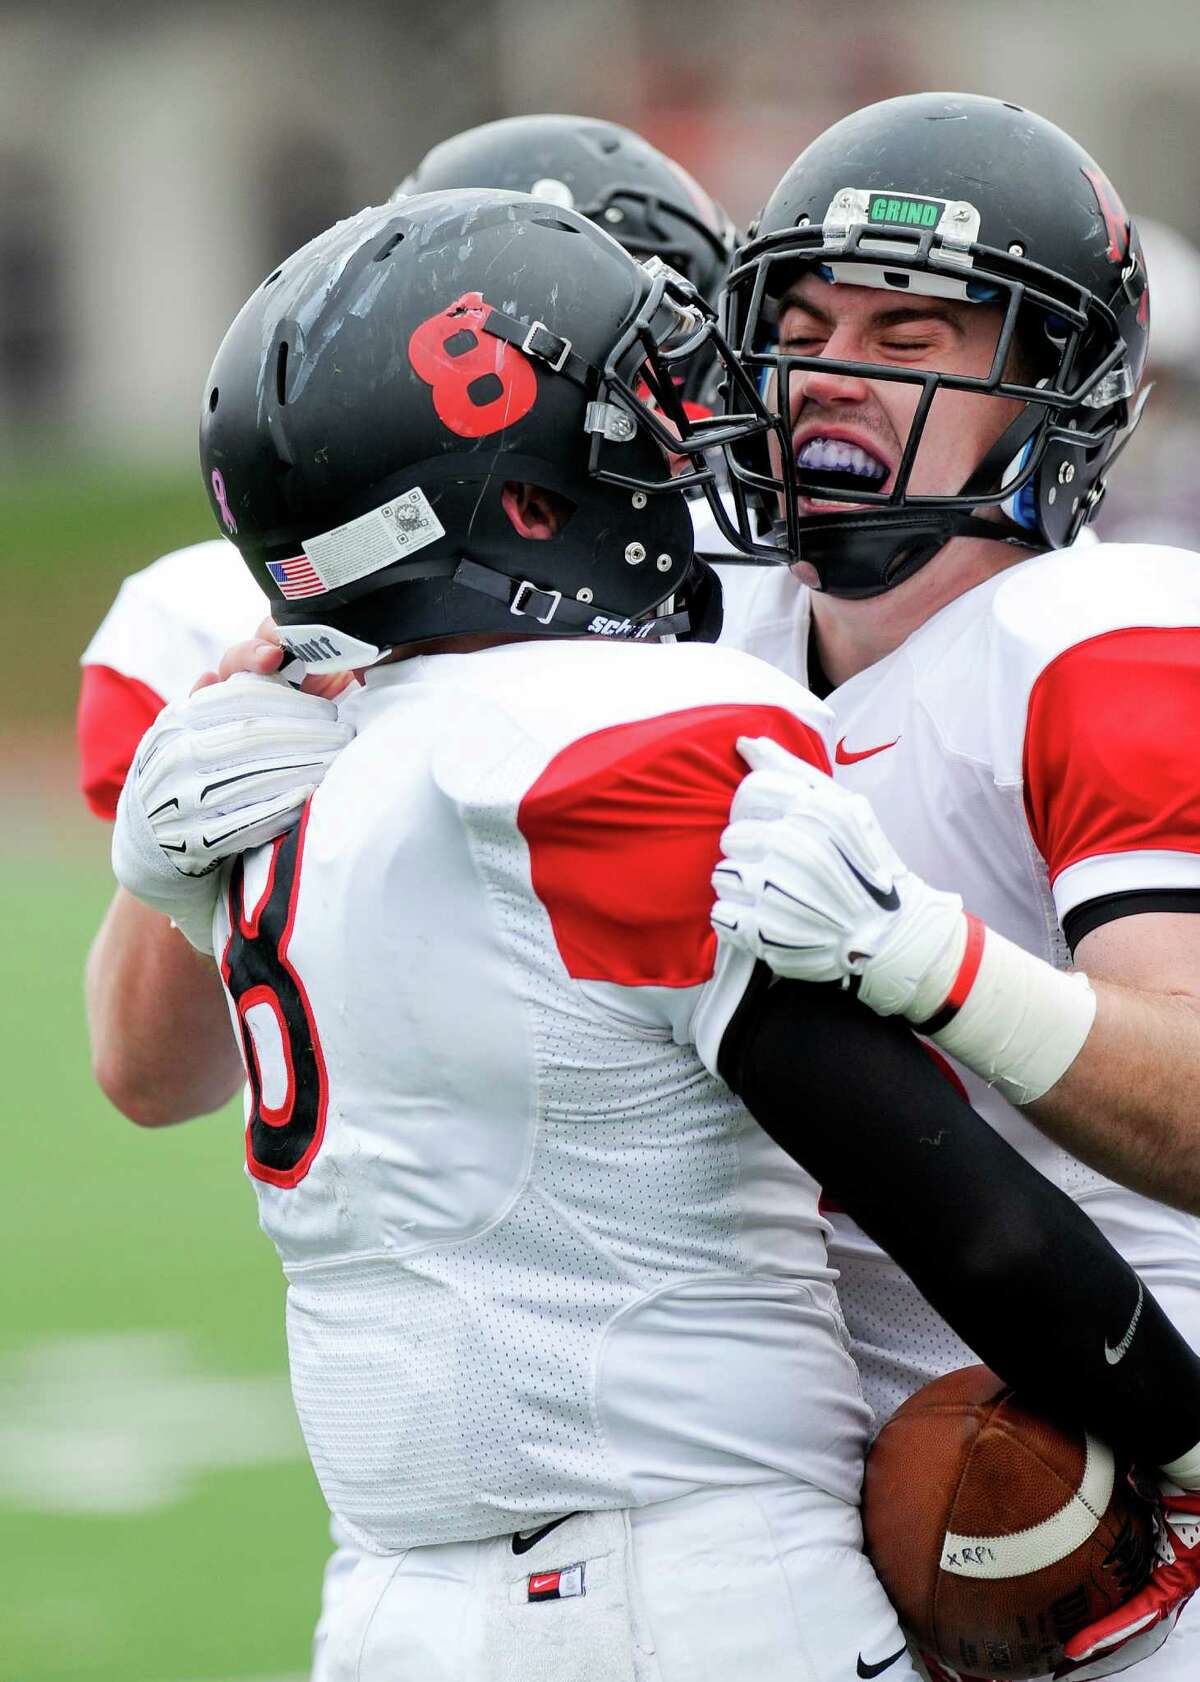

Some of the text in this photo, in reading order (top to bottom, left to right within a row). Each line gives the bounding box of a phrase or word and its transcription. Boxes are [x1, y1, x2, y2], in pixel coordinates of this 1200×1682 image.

[871, 198, 938, 226] GRIND
[408, 291, 538, 439] 8
[221, 793, 329, 1189] 8
